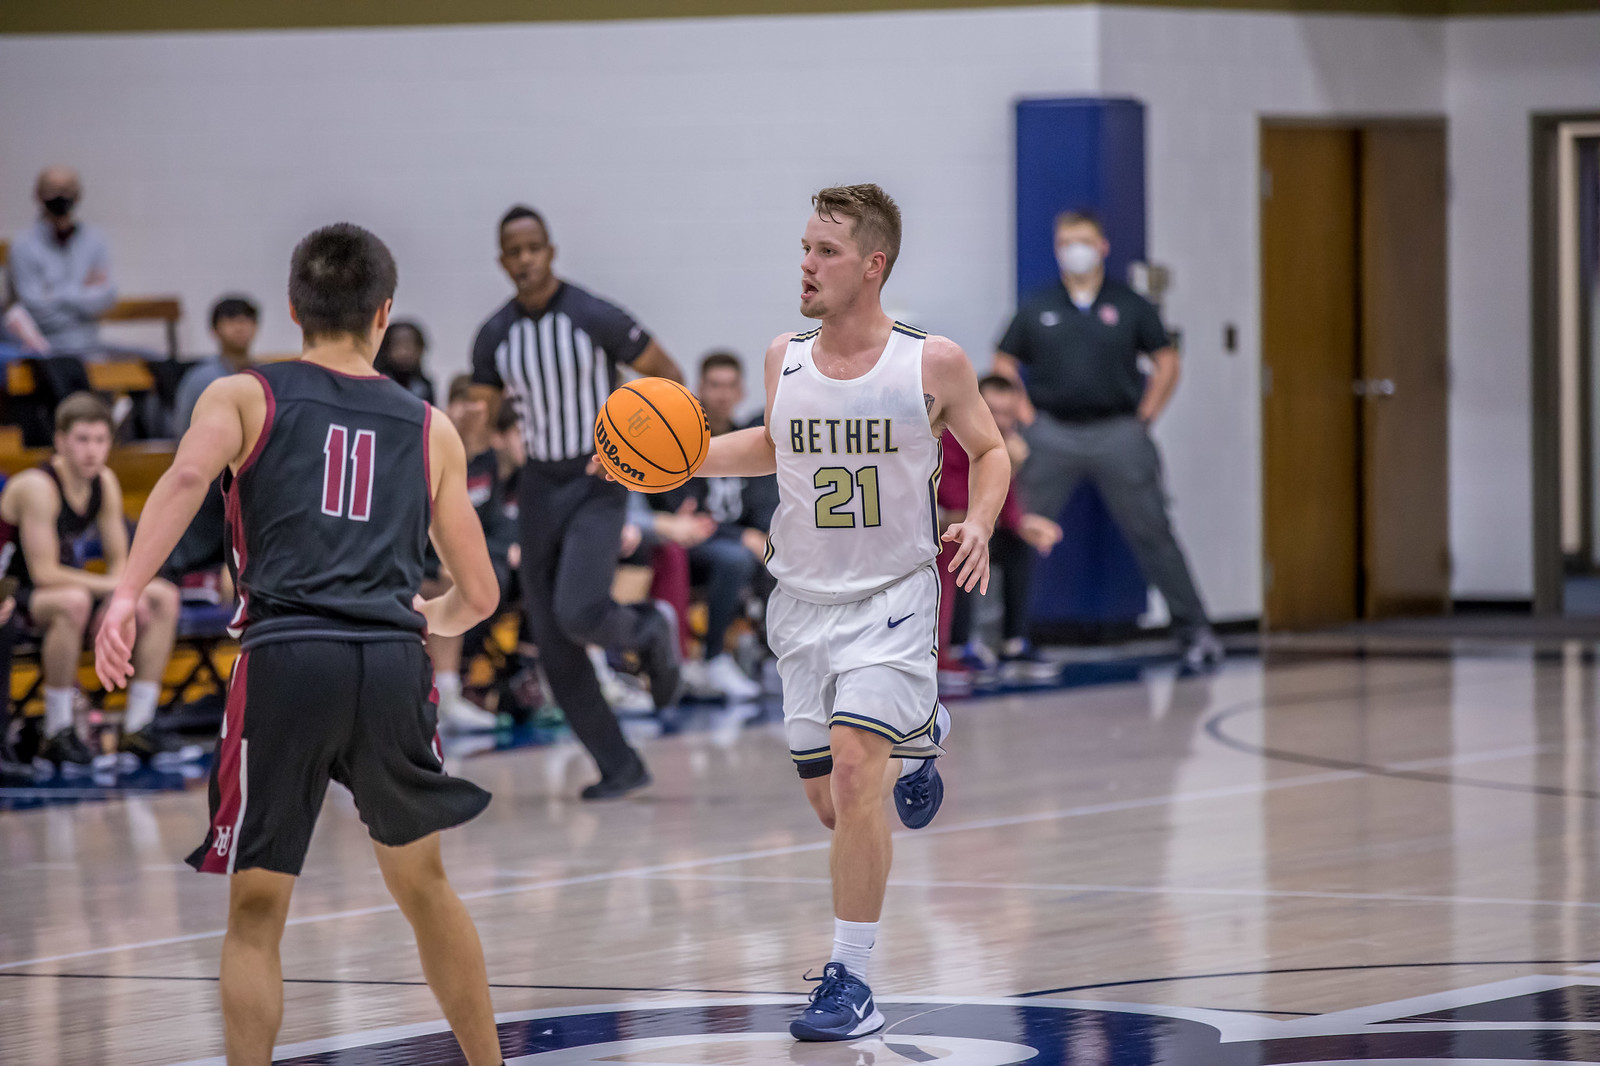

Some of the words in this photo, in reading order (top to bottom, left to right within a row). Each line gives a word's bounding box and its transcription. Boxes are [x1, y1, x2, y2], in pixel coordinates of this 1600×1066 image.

[596, 417, 646, 482] Wilson
[790, 418, 899, 454] BETHEL
[321, 423, 376, 522] 11
[813, 465, 881, 528] 21
